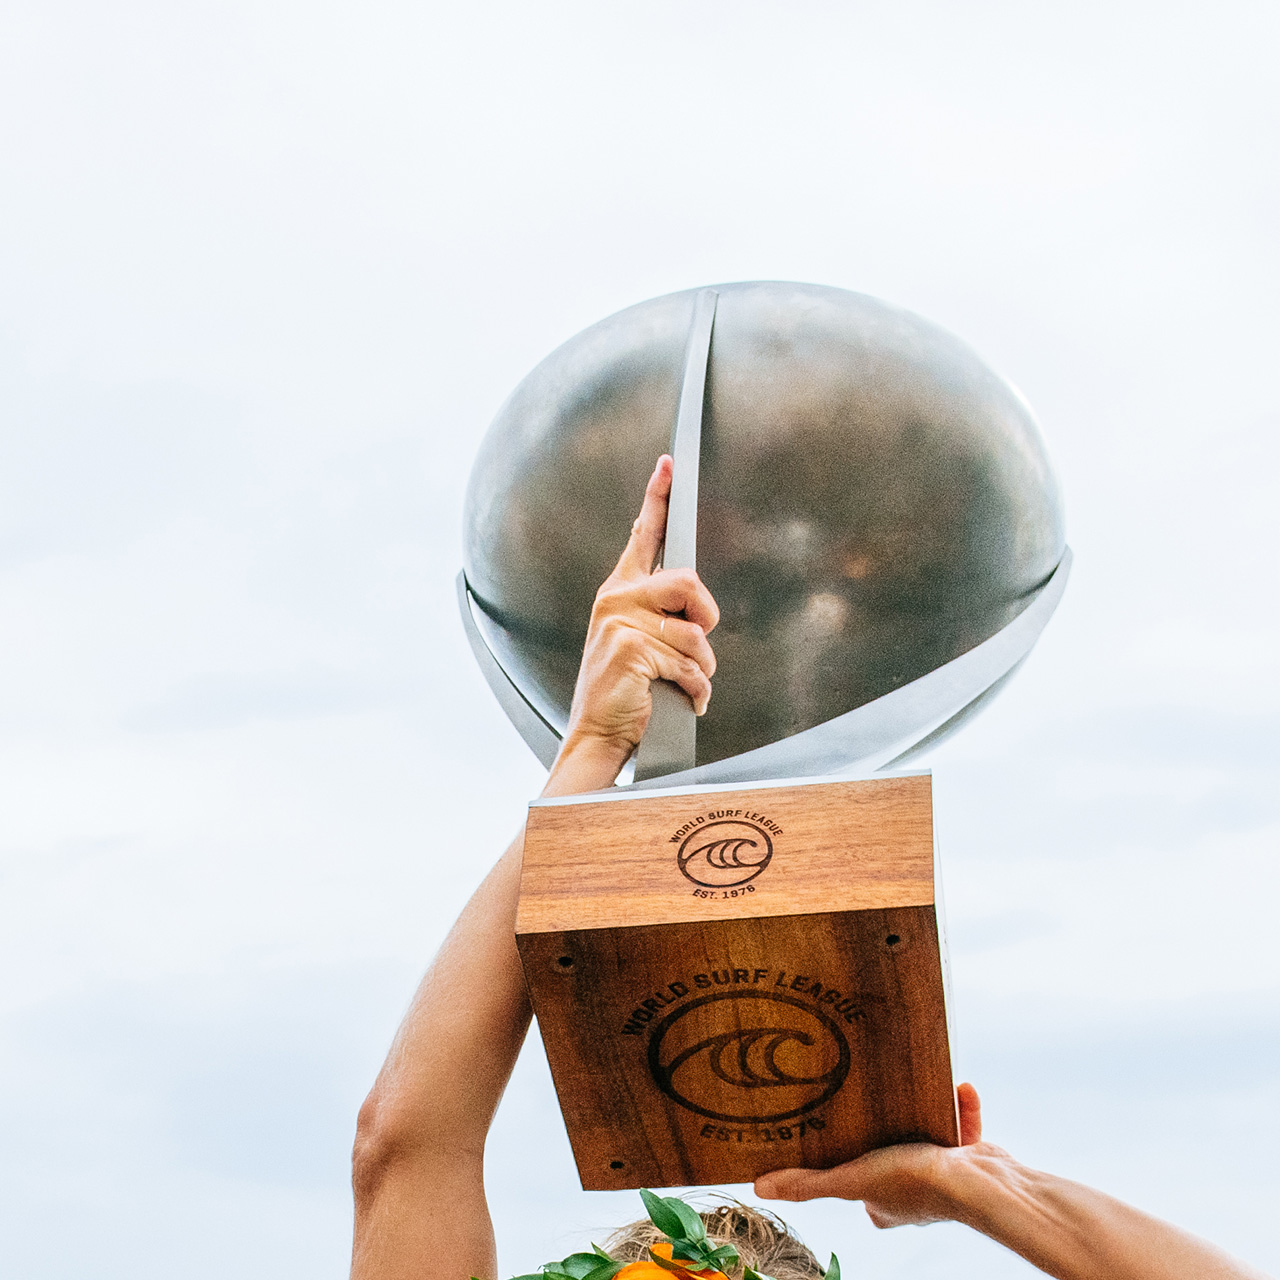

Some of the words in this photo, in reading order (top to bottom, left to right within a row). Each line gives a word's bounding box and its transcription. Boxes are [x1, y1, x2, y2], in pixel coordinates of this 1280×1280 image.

[668, 816, 706, 843] WORLD
[708, 810, 743, 820] SURF
[744, 811, 784, 837] LEAGUE
[692, 888, 718, 900] EST.
[722, 884, 756, 899] 1976
[621, 981, 690, 1037] WORLD
[693, 968, 769, 989] SURF
[775, 972, 868, 1024] LEAGUE
